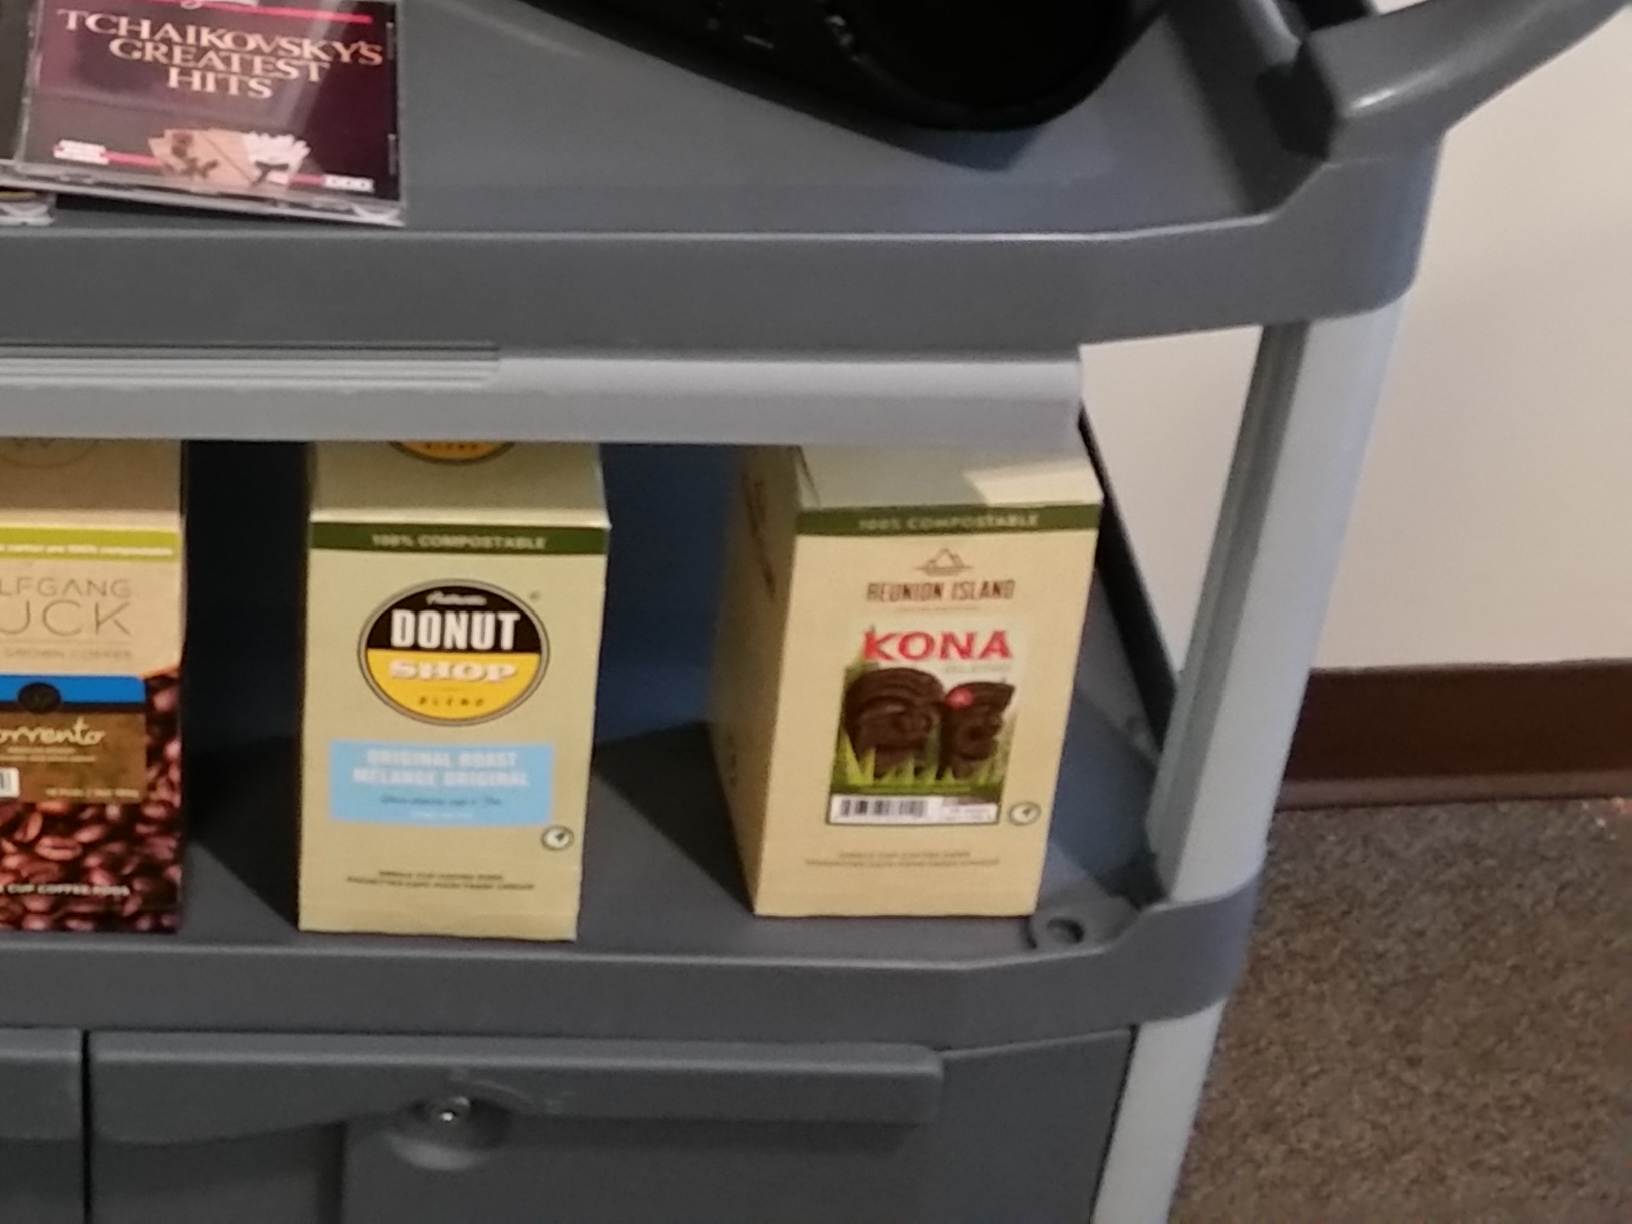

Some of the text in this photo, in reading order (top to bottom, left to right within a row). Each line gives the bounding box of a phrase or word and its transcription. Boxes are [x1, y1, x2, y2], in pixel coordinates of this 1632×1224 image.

[56, 8, 384, 67] TCHAIKOVSKY'S
[109, 37, 332, 84] GREATEST
[167, 67, 274, 100] HITS
[908, 514, 1039, 529] COMPOSTABLE
[418, 534, 547, 550] COMPOSTABLE
[866, 579, 1016, 602] REUNION ISLAND
[390, 608, 520, 651] DONUT
[863, 631, 1013, 661] KONA
[389, 659, 517, 684] SHOP
[7, 883, 35, 894] CUP
[37, 883, 90, 895] COFFEE
